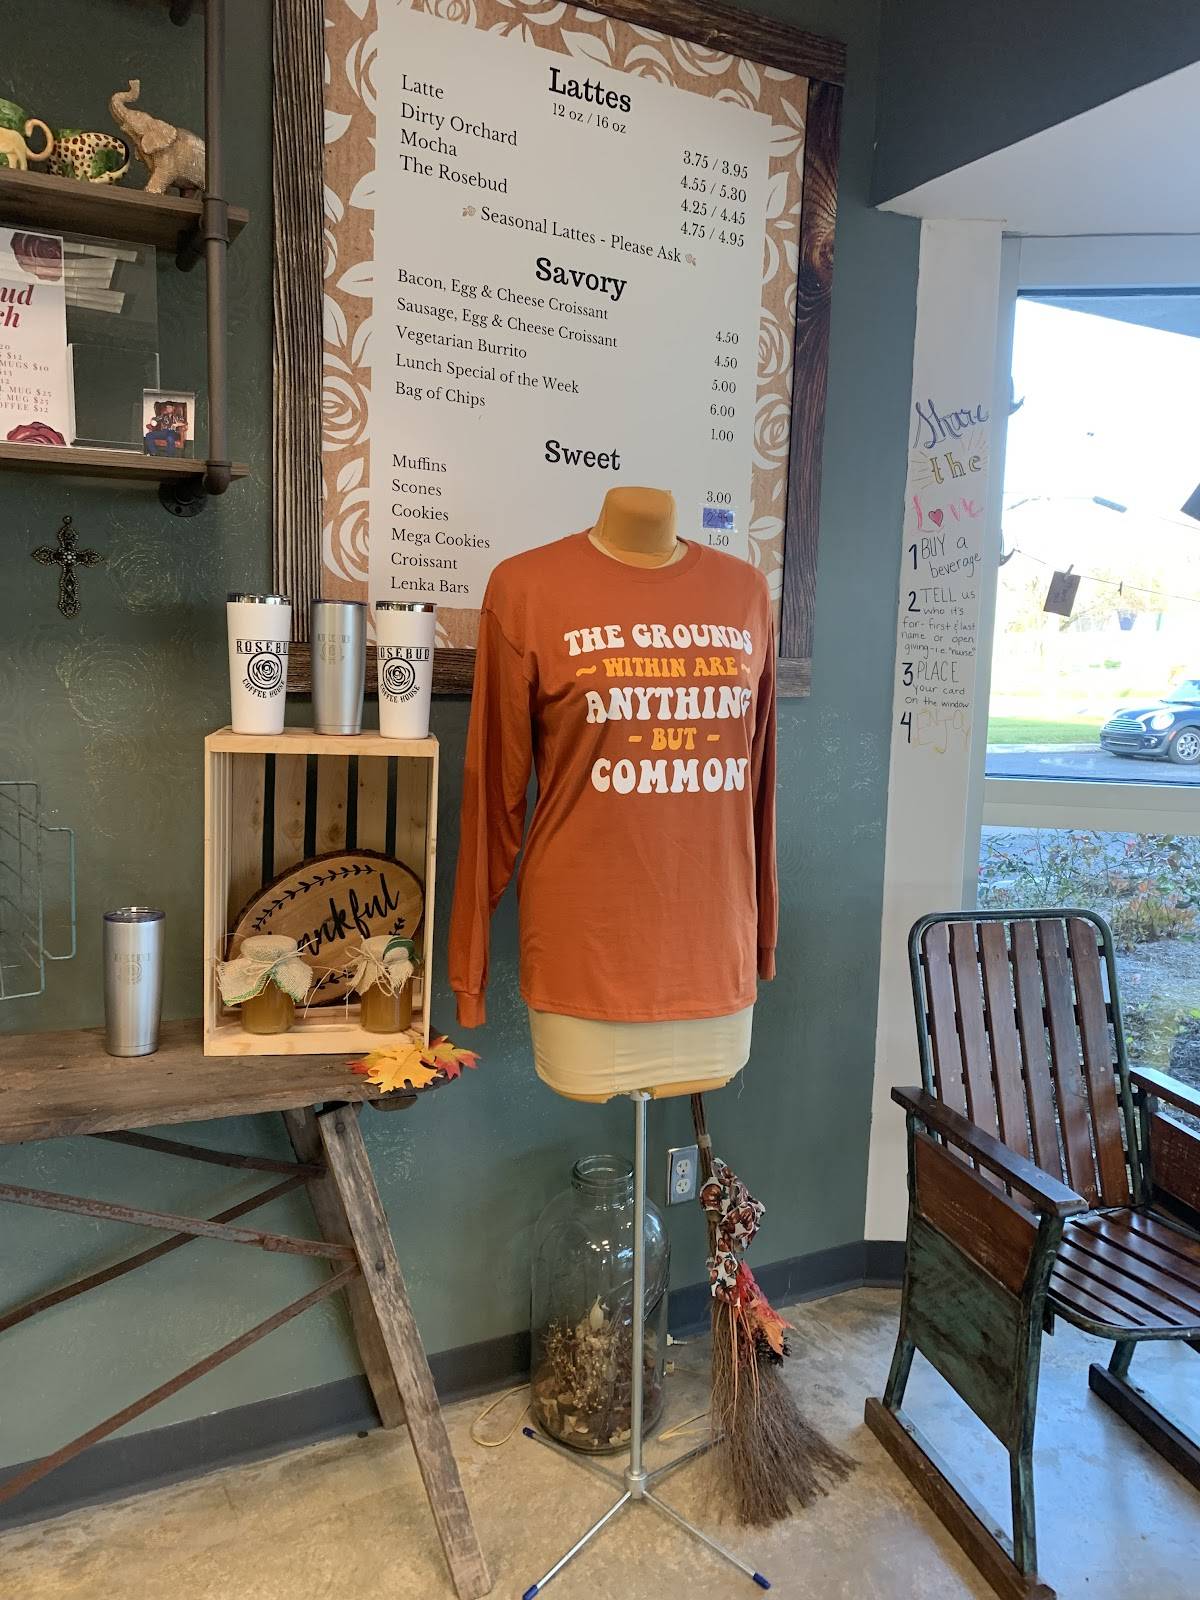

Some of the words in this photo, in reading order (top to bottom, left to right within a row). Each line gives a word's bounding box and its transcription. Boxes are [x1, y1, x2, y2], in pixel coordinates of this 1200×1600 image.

[402, 74, 444, 100] Latte
[549, 67, 631, 112] Lattes
[400, 102, 445, 130] Dirty
[450, 116, 517, 146] Orchard
[553, 103, 565, 117] 12
[569, 111, 583, 122] oz
[596, 114, 608, 128] 16
[612, 121, 626, 134] oz
[400, 129, 458, 157] Mocha
[400, 154, 433, 176] The
[438, 163, 508, 194] Rosebud
[683, 150, 708, 169] 3.75
[722, 162, 747, 179] 3.95
[680, 175, 706, 193] 4.55
[719, 186, 746, 202] 5.30
[681, 199, 707, 216] 4.25
[720, 210, 745, 225] 4.45
[481, 206, 547, 234] Seasonal
[552, 222, 595, 244] Lattes
[611, 234, 653, 256] Please
[657, 245, 681, 263] Ask
[681, 221, 705, 240] 4.75
[719, 230, 744, 247] 4.95
[536, 257, 627, 301] Savory
[397, 269, 446, 292] Bacon,
[451, 279, 477, 298] Egg
[482, 285, 493, 298] &
[497, 287, 545, 309] Cheese
[549, 296, 608, 320] Croissant
[397, 297, 457, 322] Sausage,
[462, 308, 488, 328] Egg
[491, 314, 503, 328] &
[507, 317, 555, 337] Cheese
[558, 320, 617, 347] Croissant
[395, 325, 473, 350] Vegetarian
[477, 338, 527, 360] Burrito
[715, 330, 739, 344] 4.50
[396, 353, 442, 373] Lunch
[446, 362, 496, 382] Special
[500, 369, 516, 383] of
[518, 373, 538, 387] the
[542, 376, 579, 393] Week
[714, 355, 738, 369] 4.50
[395, 381, 422, 400] Bag
[426, 387, 442, 400] of
[445, 389, 486, 408] Chips
[711, 379, 736, 394] 5.00
[710, 404, 735, 418] 6.00
[913, 399, 988, 449] Share
[711, 428, 734, 442] 1.00
[392, 454, 447, 473] Muffins
[545, 440, 620, 470] Sweet
[930, 452, 981, 485] the
[391, 478, 442, 497] Scones
[706, 491, 731, 504] 3.00
[391, 503, 449, 521] Cookies
[391, 528, 431, 545] Mega
[435, 532, 490, 549] Cookies
[708, 534, 729, 547] 1.50
[391, 552, 458, 570] Croissant
[909, 544, 917, 570] 1
[921, 534, 946, 559] BUY
[957, 536, 968, 549] a
[929, 552, 981, 578] beverage
[391, 576, 435, 593] Lenka
[439, 579, 470, 594] Bars
[908, 591, 921, 613] 2
[919, 588, 957, 603] TELL
[961, 591, 976, 600] us
[923, 606, 945, 615] who
[564, 625, 625, 656] THE
[631, 624, 753, 655] GROUNDS
[901, 631, 926, 640] name
[933, 634, 944, 643] or
[951, 635, 975, 647] open
[602, 657, 686, 678] WITHIN
[693, 656, 738, 677] ARE
[902, 662, 914, 686] 3
[917, 661, 960, 683] PLACE
[242, 678, 268, 699] COFFEE
[399, 684, 421, 703] HOUSE
[913, 684, 937, 695] your
[942, 686, 965, 695] card
[923, 696, 937, 706] the
[941, 700, 969, 708] window
[651, 728, 697, 751] BUT
[900, 711, 912, 744] 4
[591, 757, 748, 794] COMMON
